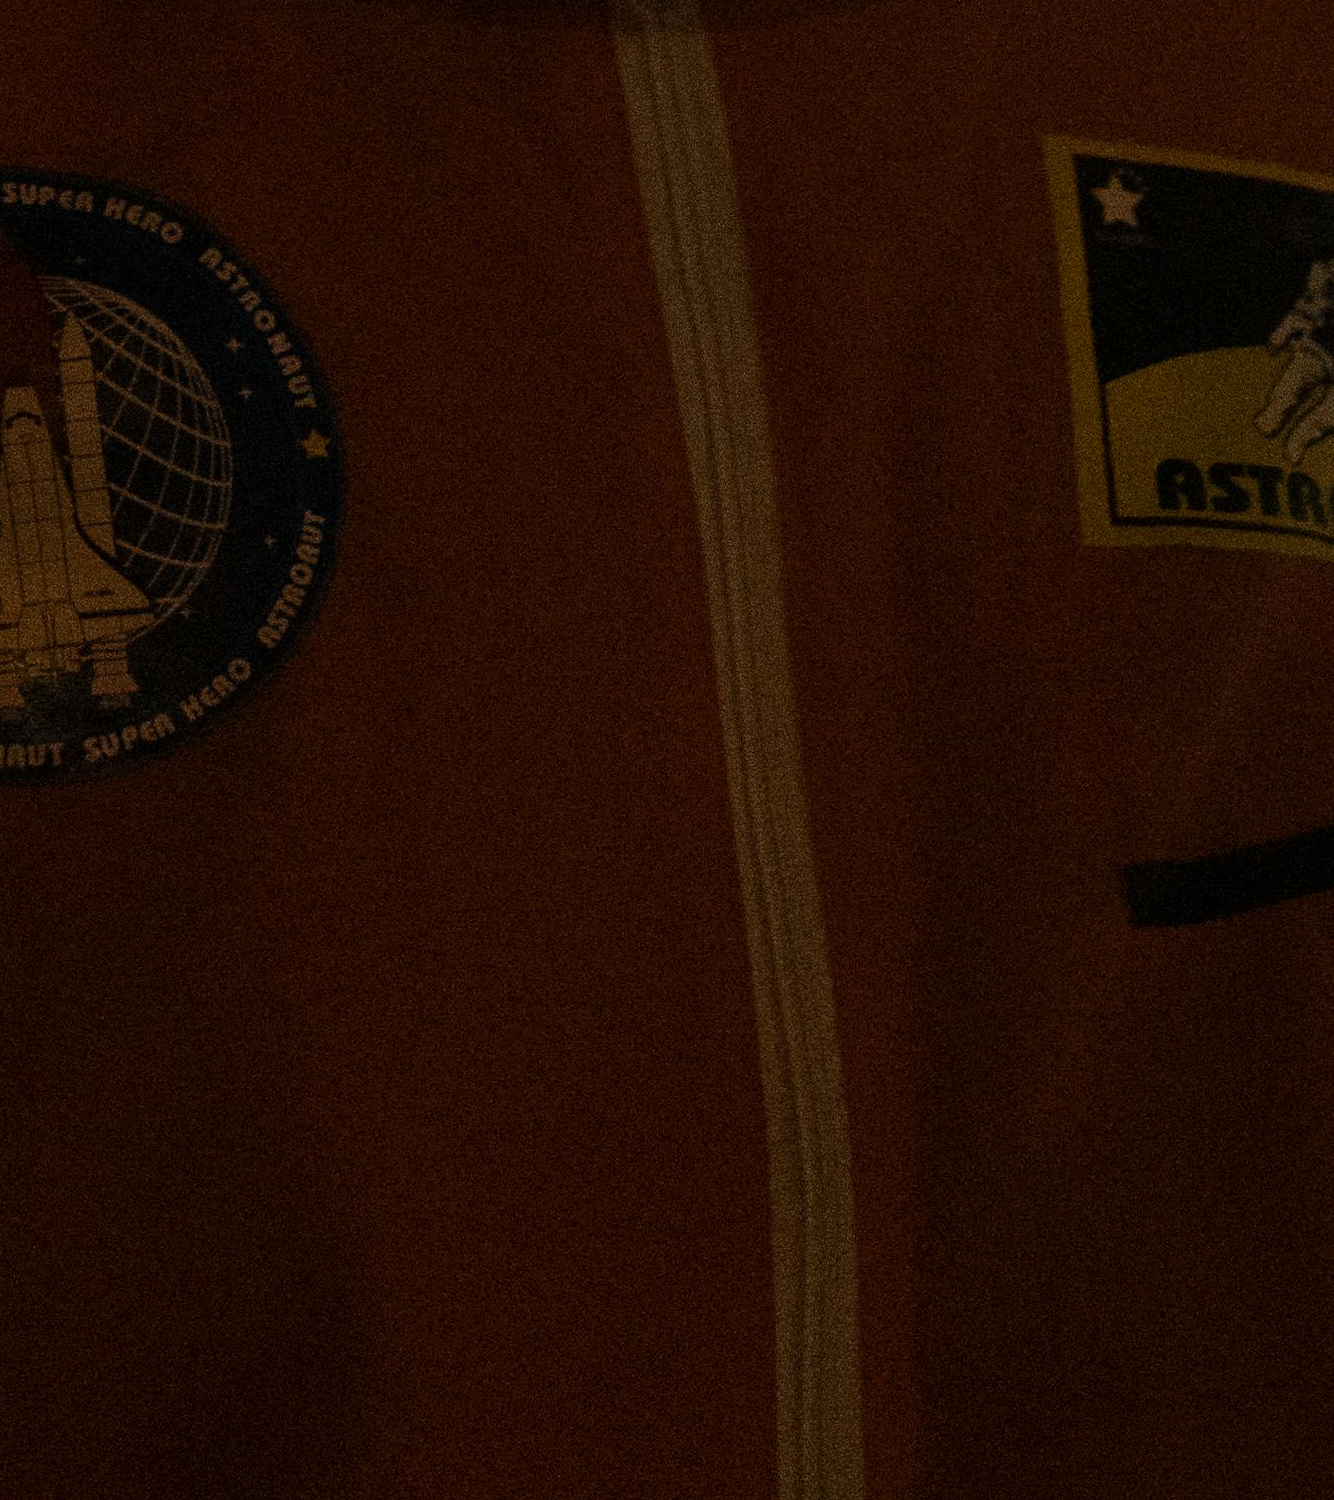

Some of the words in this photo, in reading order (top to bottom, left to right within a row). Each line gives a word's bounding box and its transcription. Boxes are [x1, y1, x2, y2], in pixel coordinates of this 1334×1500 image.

[1, 182, 95, 213] SUPER
[103, 198, 185, 245] HERO
[198, 247, 316, 409] ASTRONAUT
[83, 712, 177, 764] SUPER
[179, 657, 252, 722] HERO
